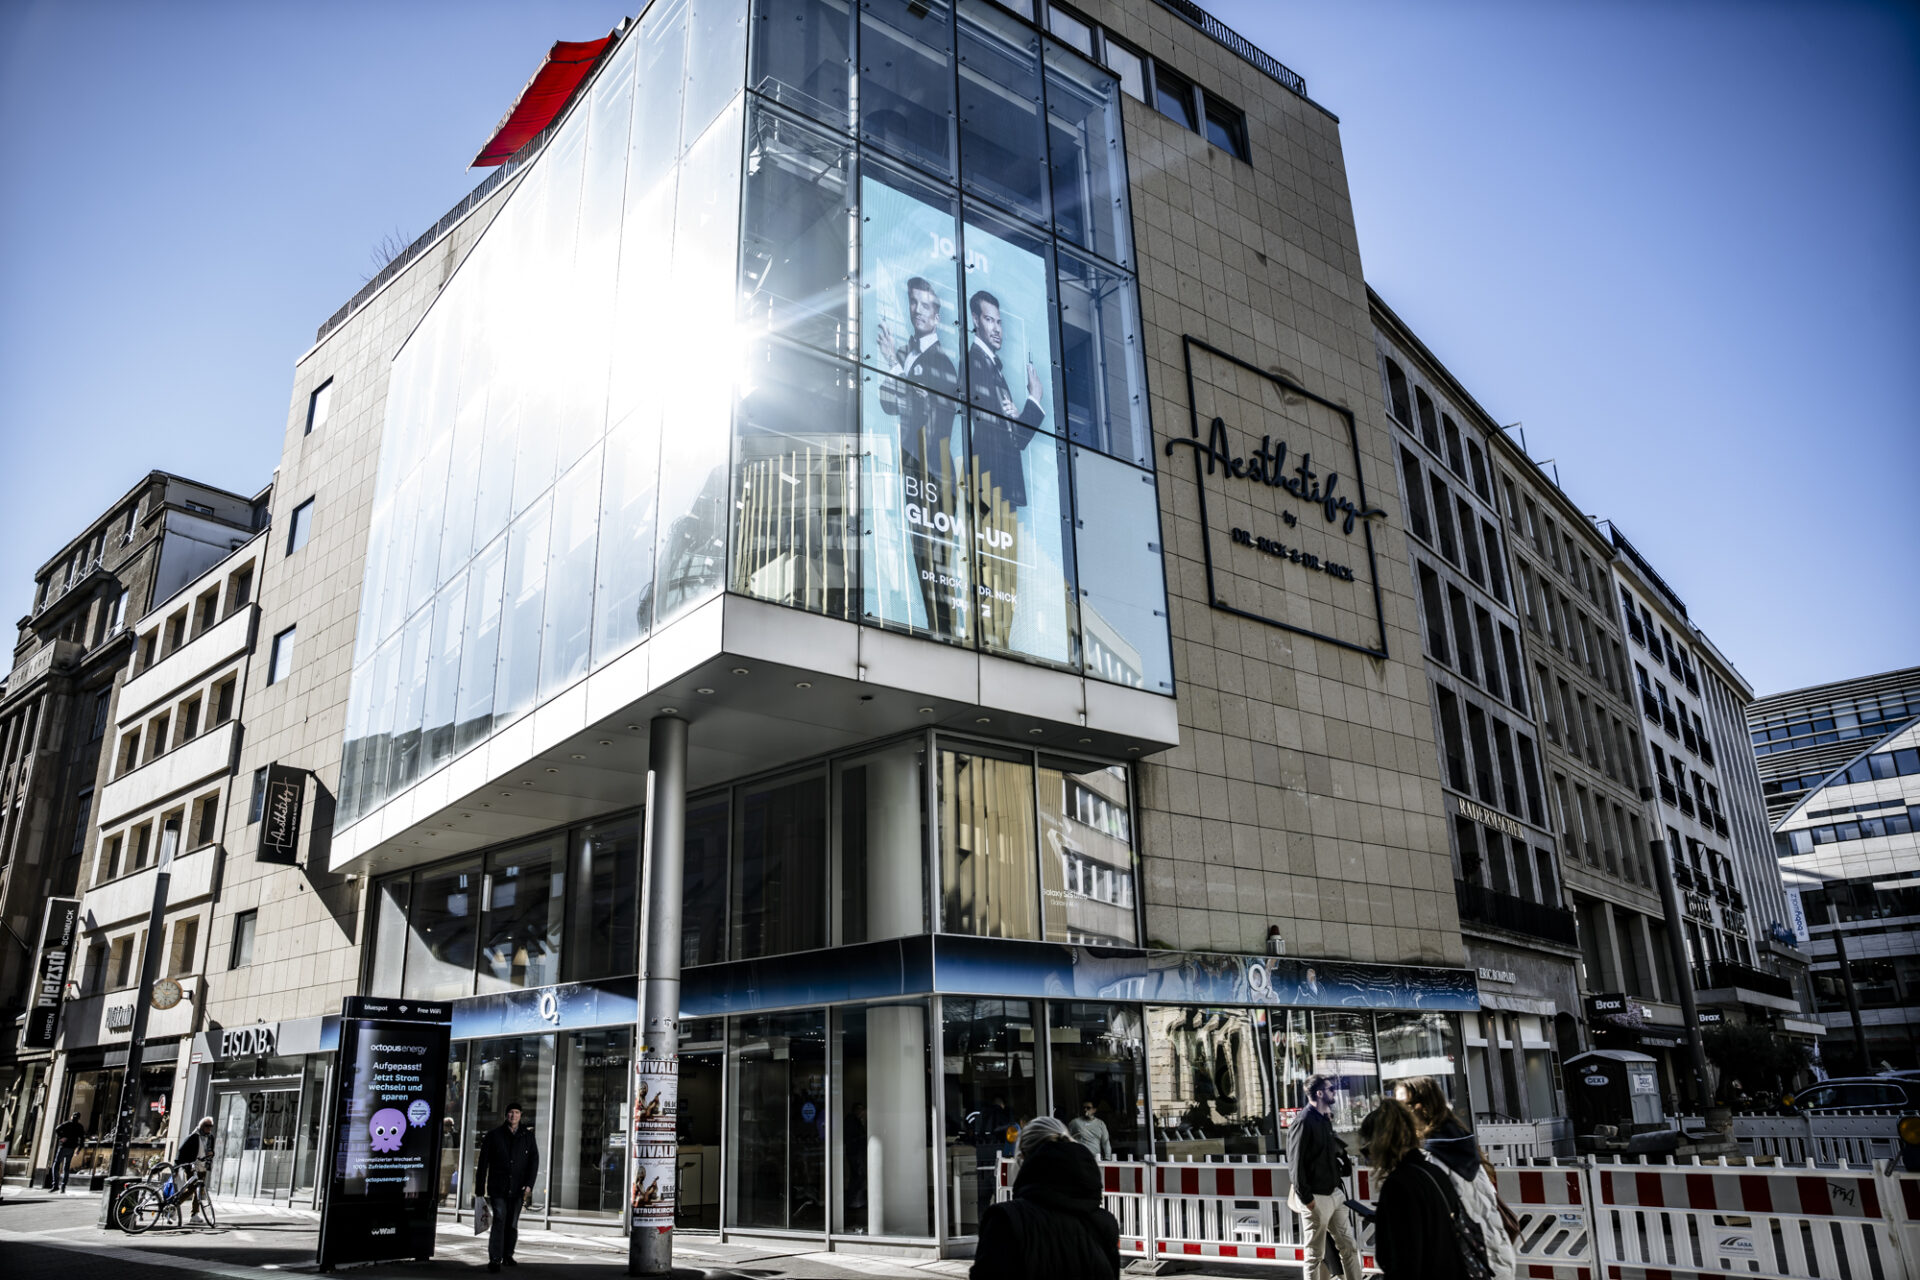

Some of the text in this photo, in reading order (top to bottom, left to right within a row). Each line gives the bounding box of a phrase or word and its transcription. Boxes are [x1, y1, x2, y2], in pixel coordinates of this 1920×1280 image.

[1165, 416, 1388, 536] Aesthetify
[905, 475, 937, 503] BIS
[1283, 510, 1297, 528] by
[1256, 536, 1288, 559] RICK
[1325, 560, 1355, 582] NICK
[939, 574, 962, 588] RICK
[995, 591, 1018, 604] NICK
[1457, 797, 1525, 839] RADERMACHER
[61, 909, 75, 946] SCHMUCK
[364, 1003, 388, 1013] bluespot
[1595, 1000, 1621, 1010] Brax
[1699, 1013, 1721, 1022] Brax
[44, 1013, 56, 1040] UHREN
[372, 1061, 422, 1072] Aufgepasst!
[639, 1061, 678, 1073] VIVALD
[373, 1073, 420, 1082] Jetzt Strom
[368, 1083, 423, 1092] wechseln und
[381, 1094, 409, 1103] sparen
[637, 1146, 675, 1158] VIVALD
[379, 1227, 396, 1235] Wall
